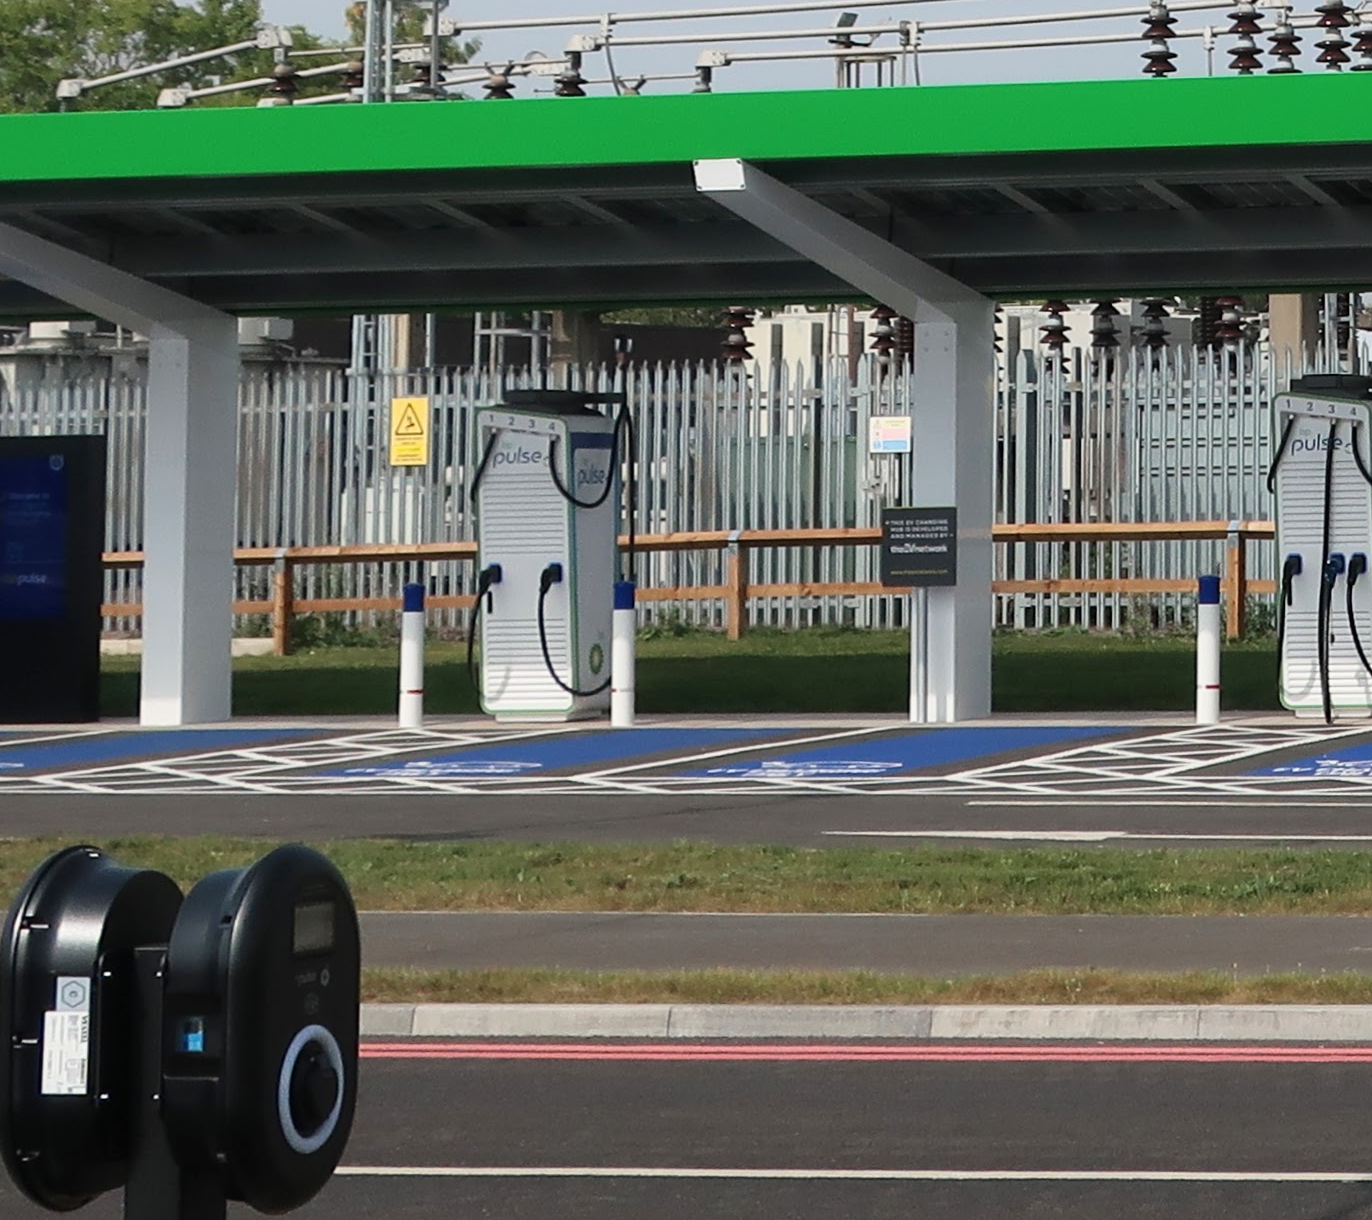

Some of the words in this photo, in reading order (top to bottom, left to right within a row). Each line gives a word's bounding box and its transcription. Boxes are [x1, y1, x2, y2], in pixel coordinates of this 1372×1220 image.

[1286, 399, 1292, 409] 1
[1306, 401, 1314, 412] 2
[1328, 404, 1336, 414] 3
[1350, 407, 1357, 416] 4
[489, 414, 495, 422] 1
[508, 417, 516, 427] 2
[528, 419, 536, 429] 3
[548, 422, 556, 431] 4
[492, 445, 542, 468] pulse
